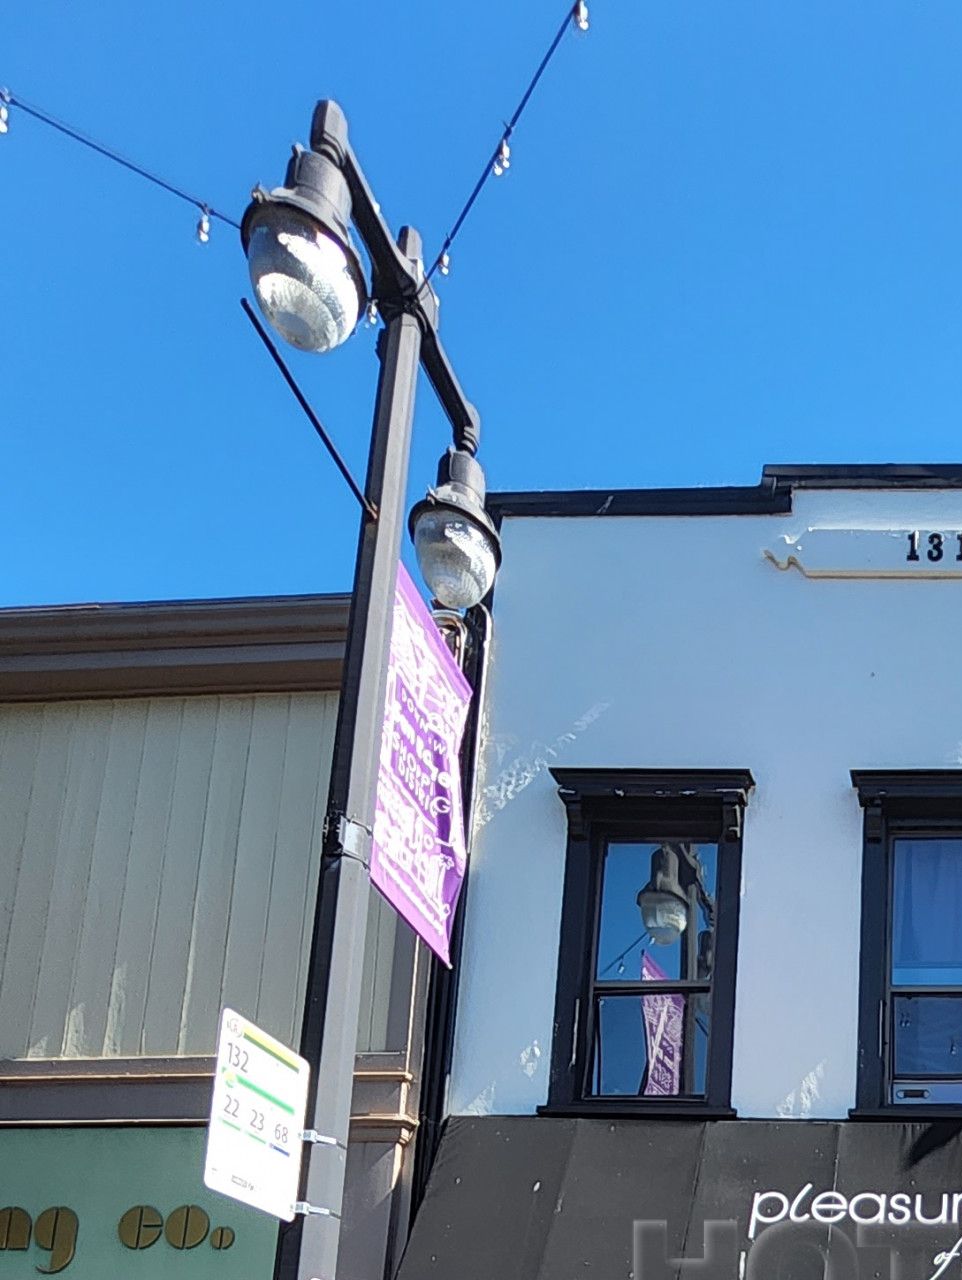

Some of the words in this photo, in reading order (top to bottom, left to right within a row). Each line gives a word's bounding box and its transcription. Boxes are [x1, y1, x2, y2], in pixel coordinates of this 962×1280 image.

[227, 1042, 249, 1073] 132
[224, 1094, 240, 1118] 22
[250, 1108, 265, 1132] 23
[274, 1123, 289, 1144] 68
